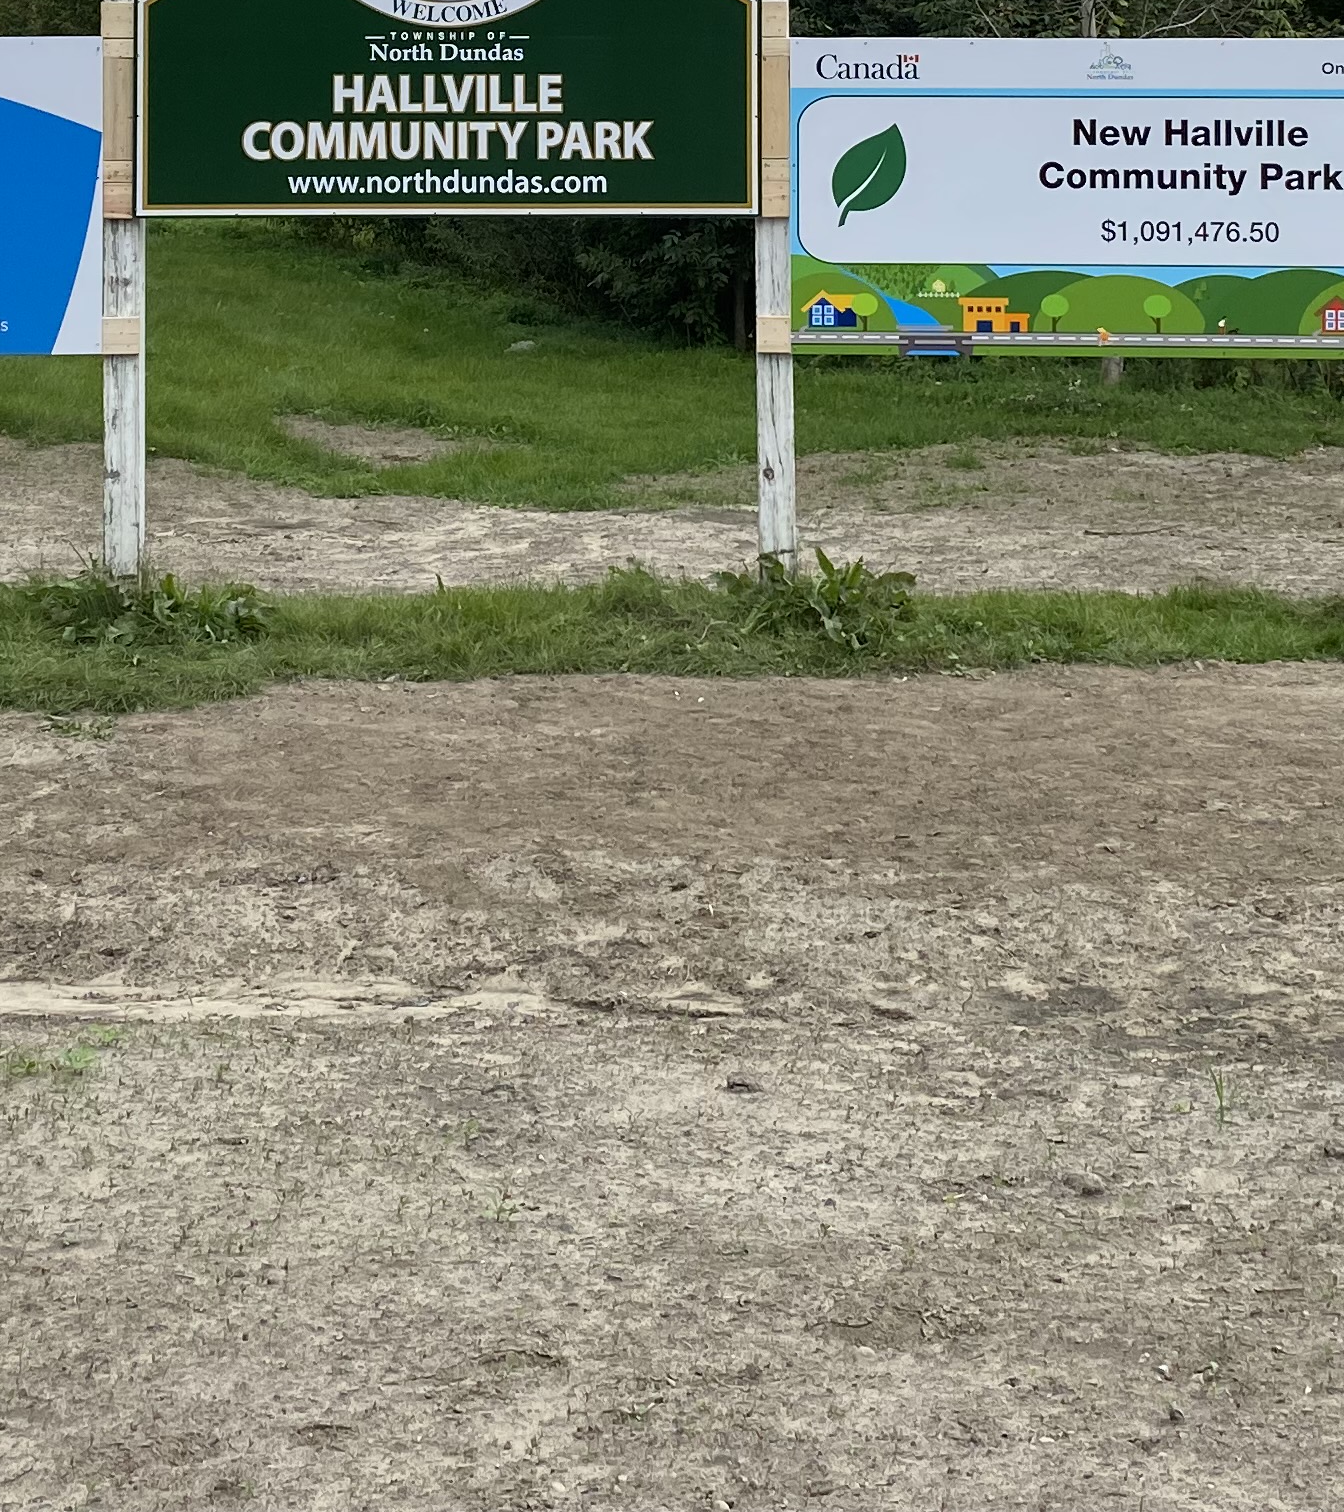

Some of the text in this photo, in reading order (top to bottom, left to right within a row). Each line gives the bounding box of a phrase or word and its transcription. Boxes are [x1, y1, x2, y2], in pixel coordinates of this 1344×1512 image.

[389, 31, 506, 41] TOWNSHIP OF
[369, 42, 524, 62] North Dundas
[815, 53, 920, 80] Canada
[332, 73, 564, 113] HALLVILLE
[242, 120, 655, 161] COMMUNITY PARK
[1073, 118, 1309, 147] New Hallville
[287, 168, 608, 194] www.northdundas.com
[1038, 161, 1344, 196] Community Park
[1100, 218, 1280, 247] $1,091,476.50
